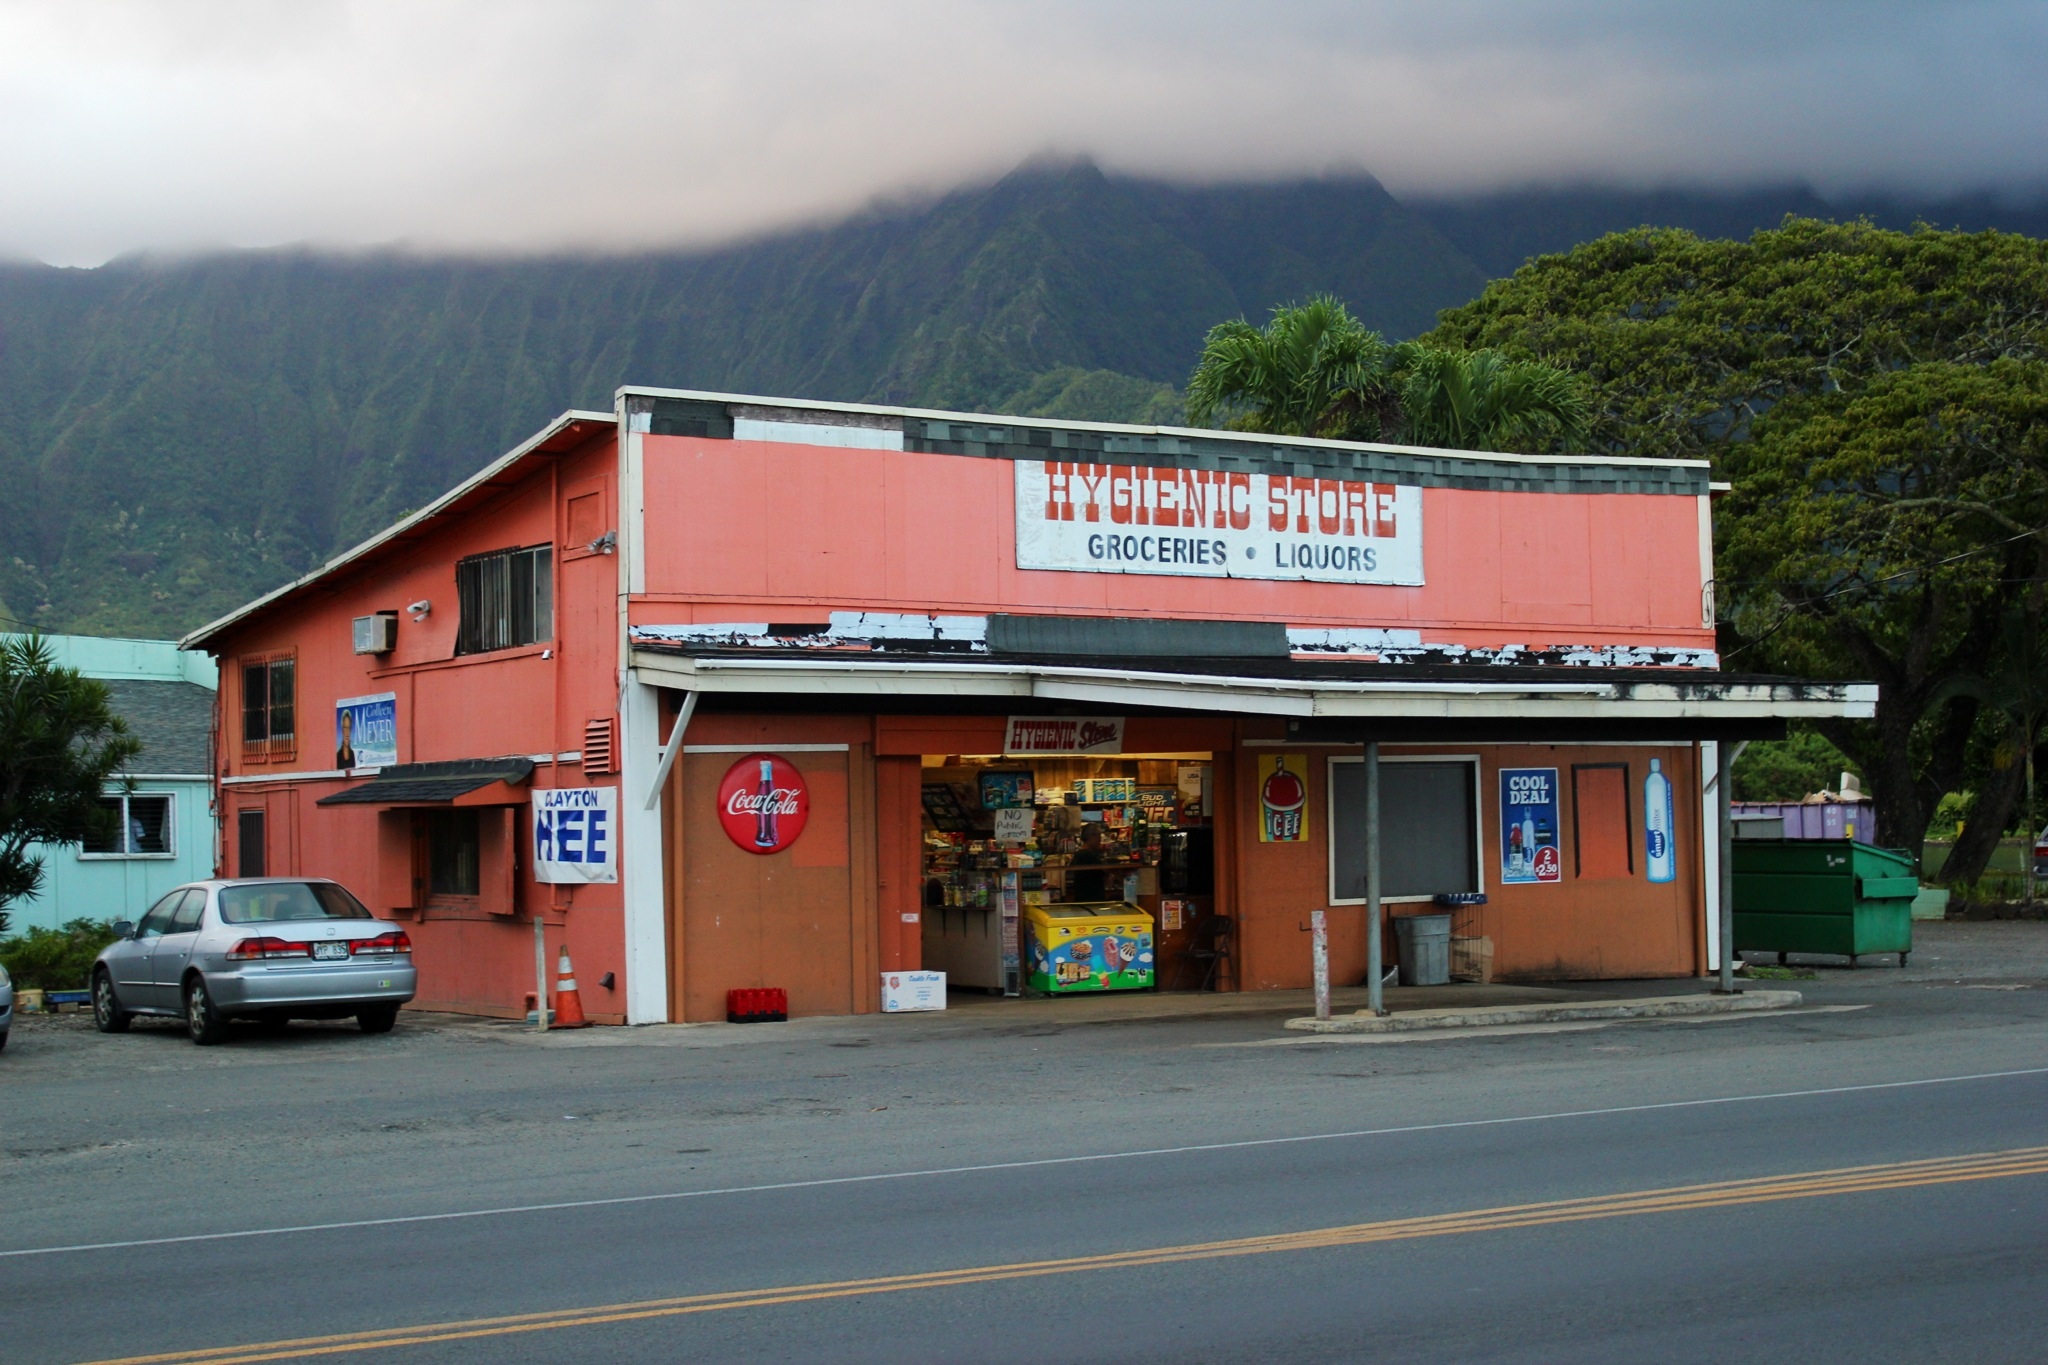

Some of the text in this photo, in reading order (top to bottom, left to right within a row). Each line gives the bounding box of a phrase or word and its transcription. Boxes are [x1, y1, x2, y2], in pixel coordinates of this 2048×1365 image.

[1044, 461, 1397, 538] HYGIENIC STORE
[1088, 534, 1377, 572] GROCERIES LIQUORS
[366, 703, 392, 718] Colleen
[354, 707, 393, 745] MEYER
[1010, 720, 1077, 750] HYGIENIC
[1510, 776, 1549, 790] COOL
[545, 790, 598, 807] CLAYTON
[727, 789, 801, 815] Coca-Cola
[1510, 790, 1549, 804] DEAL
[1005, 810, 1022, 820] NO
[1266, 813, 1300, 836] ICEE
[537, 810, 606, 863] HEE
[1544, 849, 1551, 860] 2
